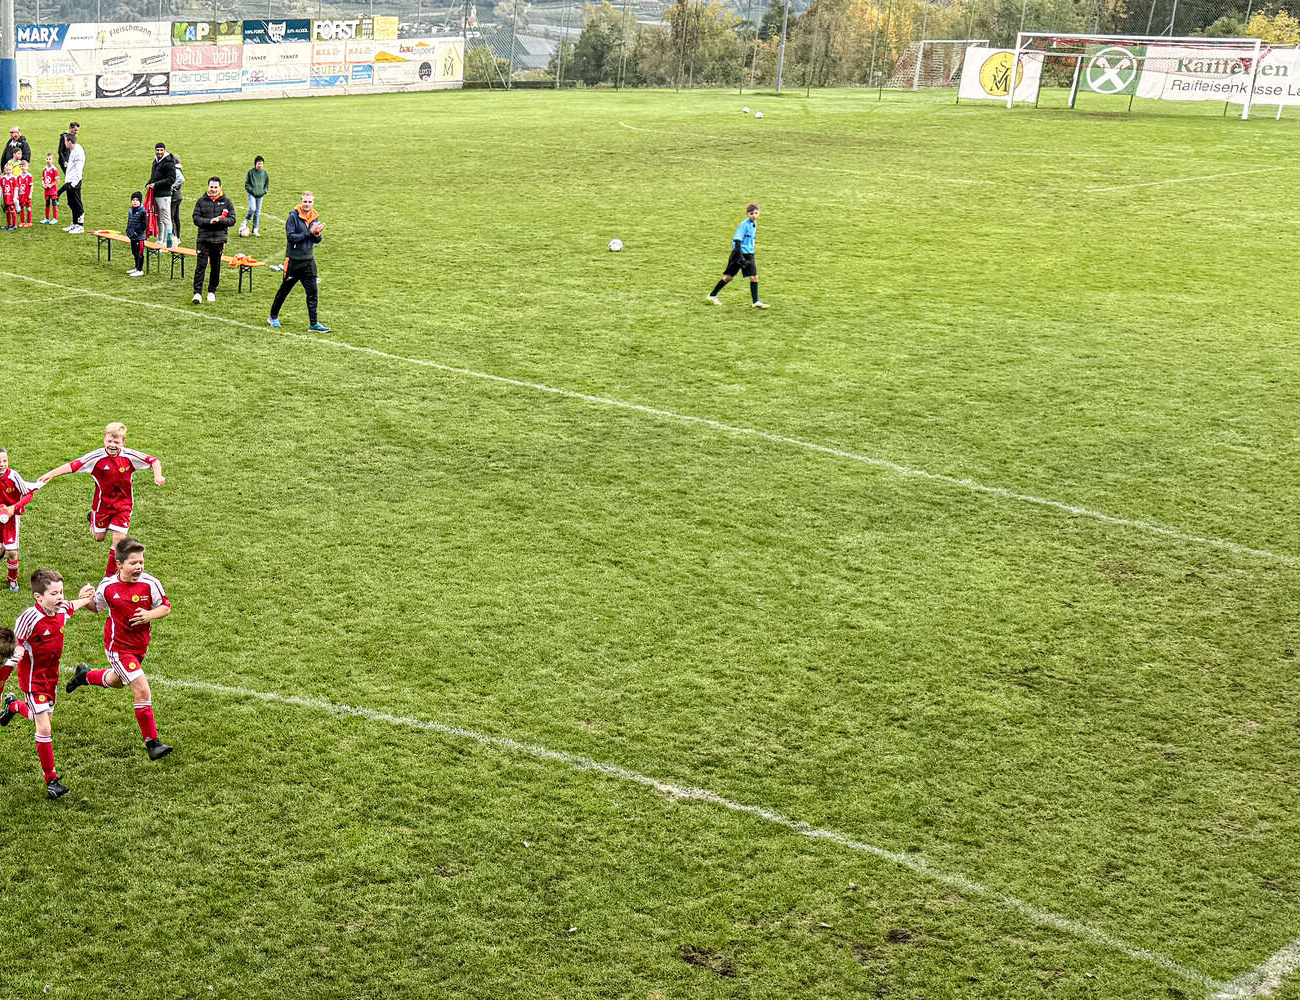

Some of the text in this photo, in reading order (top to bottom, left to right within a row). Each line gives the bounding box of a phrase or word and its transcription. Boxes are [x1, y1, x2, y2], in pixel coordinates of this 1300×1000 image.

[18, 26, 59, 47] MARX
[109, 24, 152, 37] Fleischmann
[313, 20, 360, 40] FORST
[1177, 58, 1288, 77] Raiffeien
[1171, 79, 1282, 96] Raiffeisenksse
